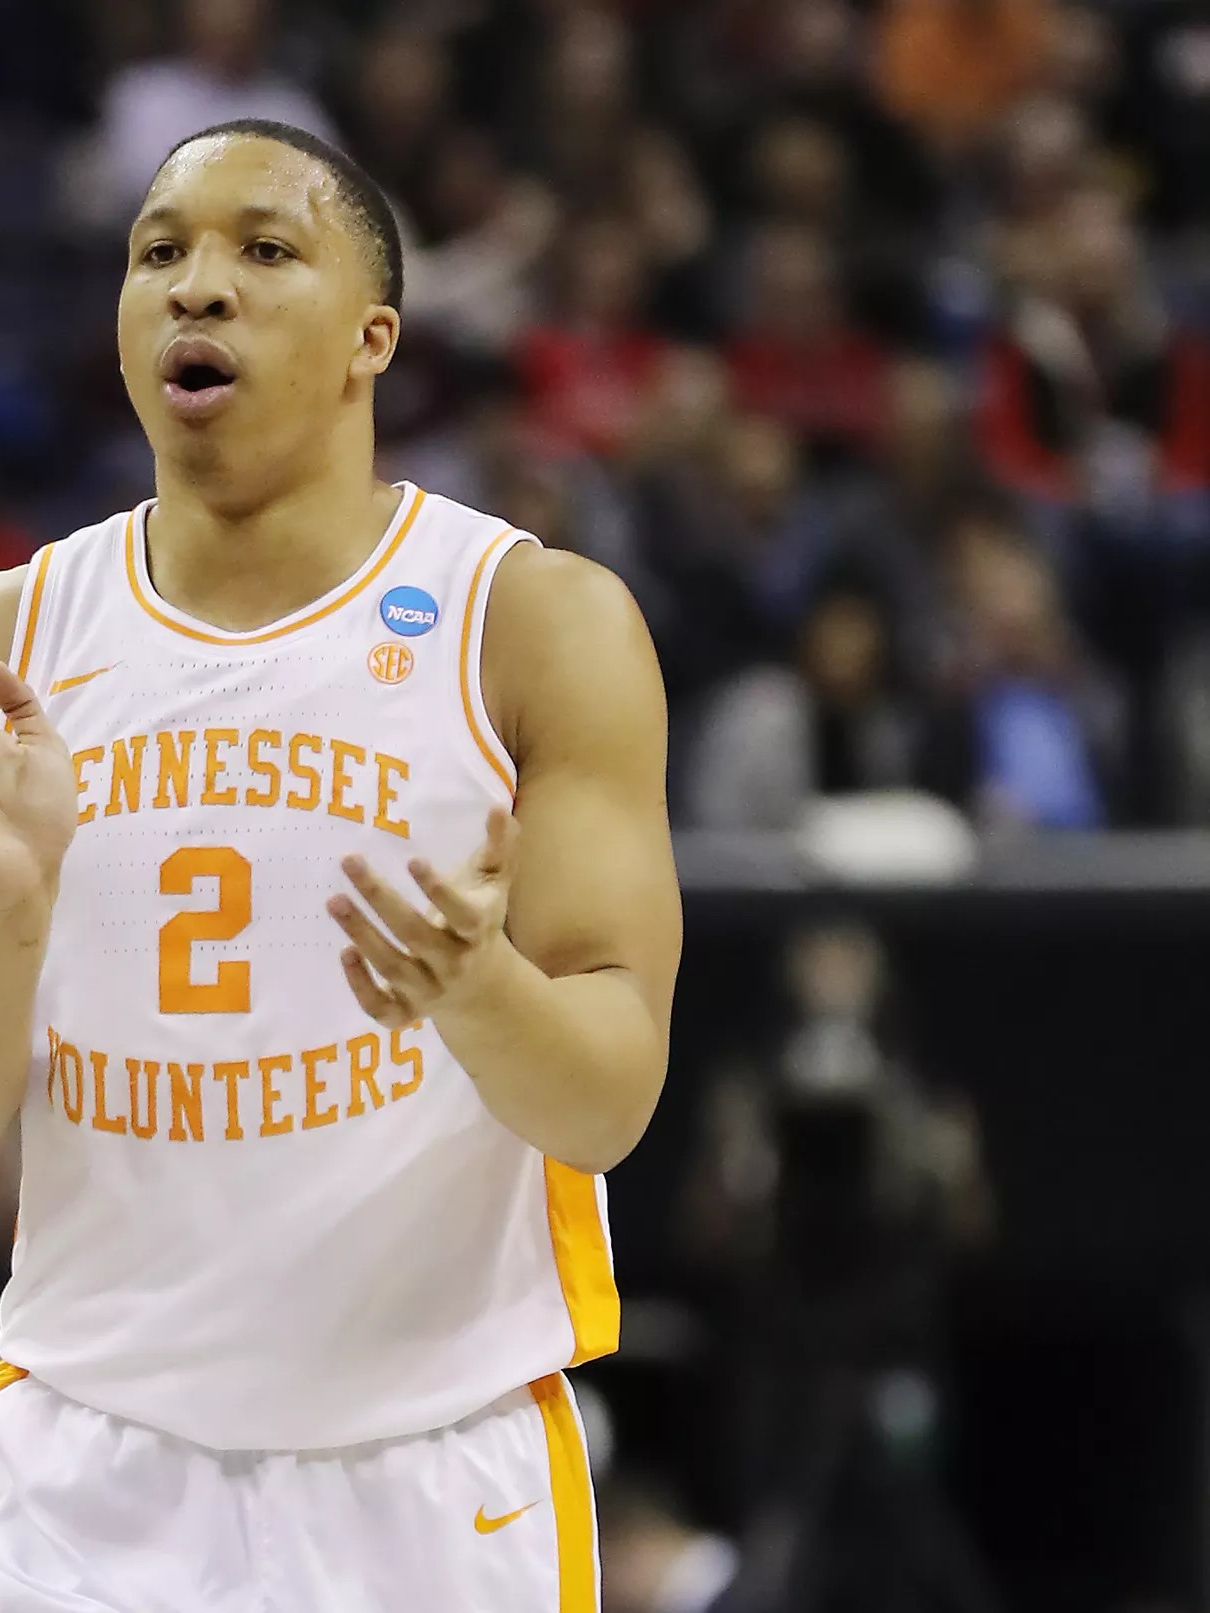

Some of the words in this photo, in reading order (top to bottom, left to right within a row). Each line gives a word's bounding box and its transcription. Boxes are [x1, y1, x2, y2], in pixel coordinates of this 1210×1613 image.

[387, 604, 436, 625] NCAA
[372, 643, 410, 680] SEC
[72, 728, 411, 840] ENNESSEE
[158, 846, 252, 1014] 2
